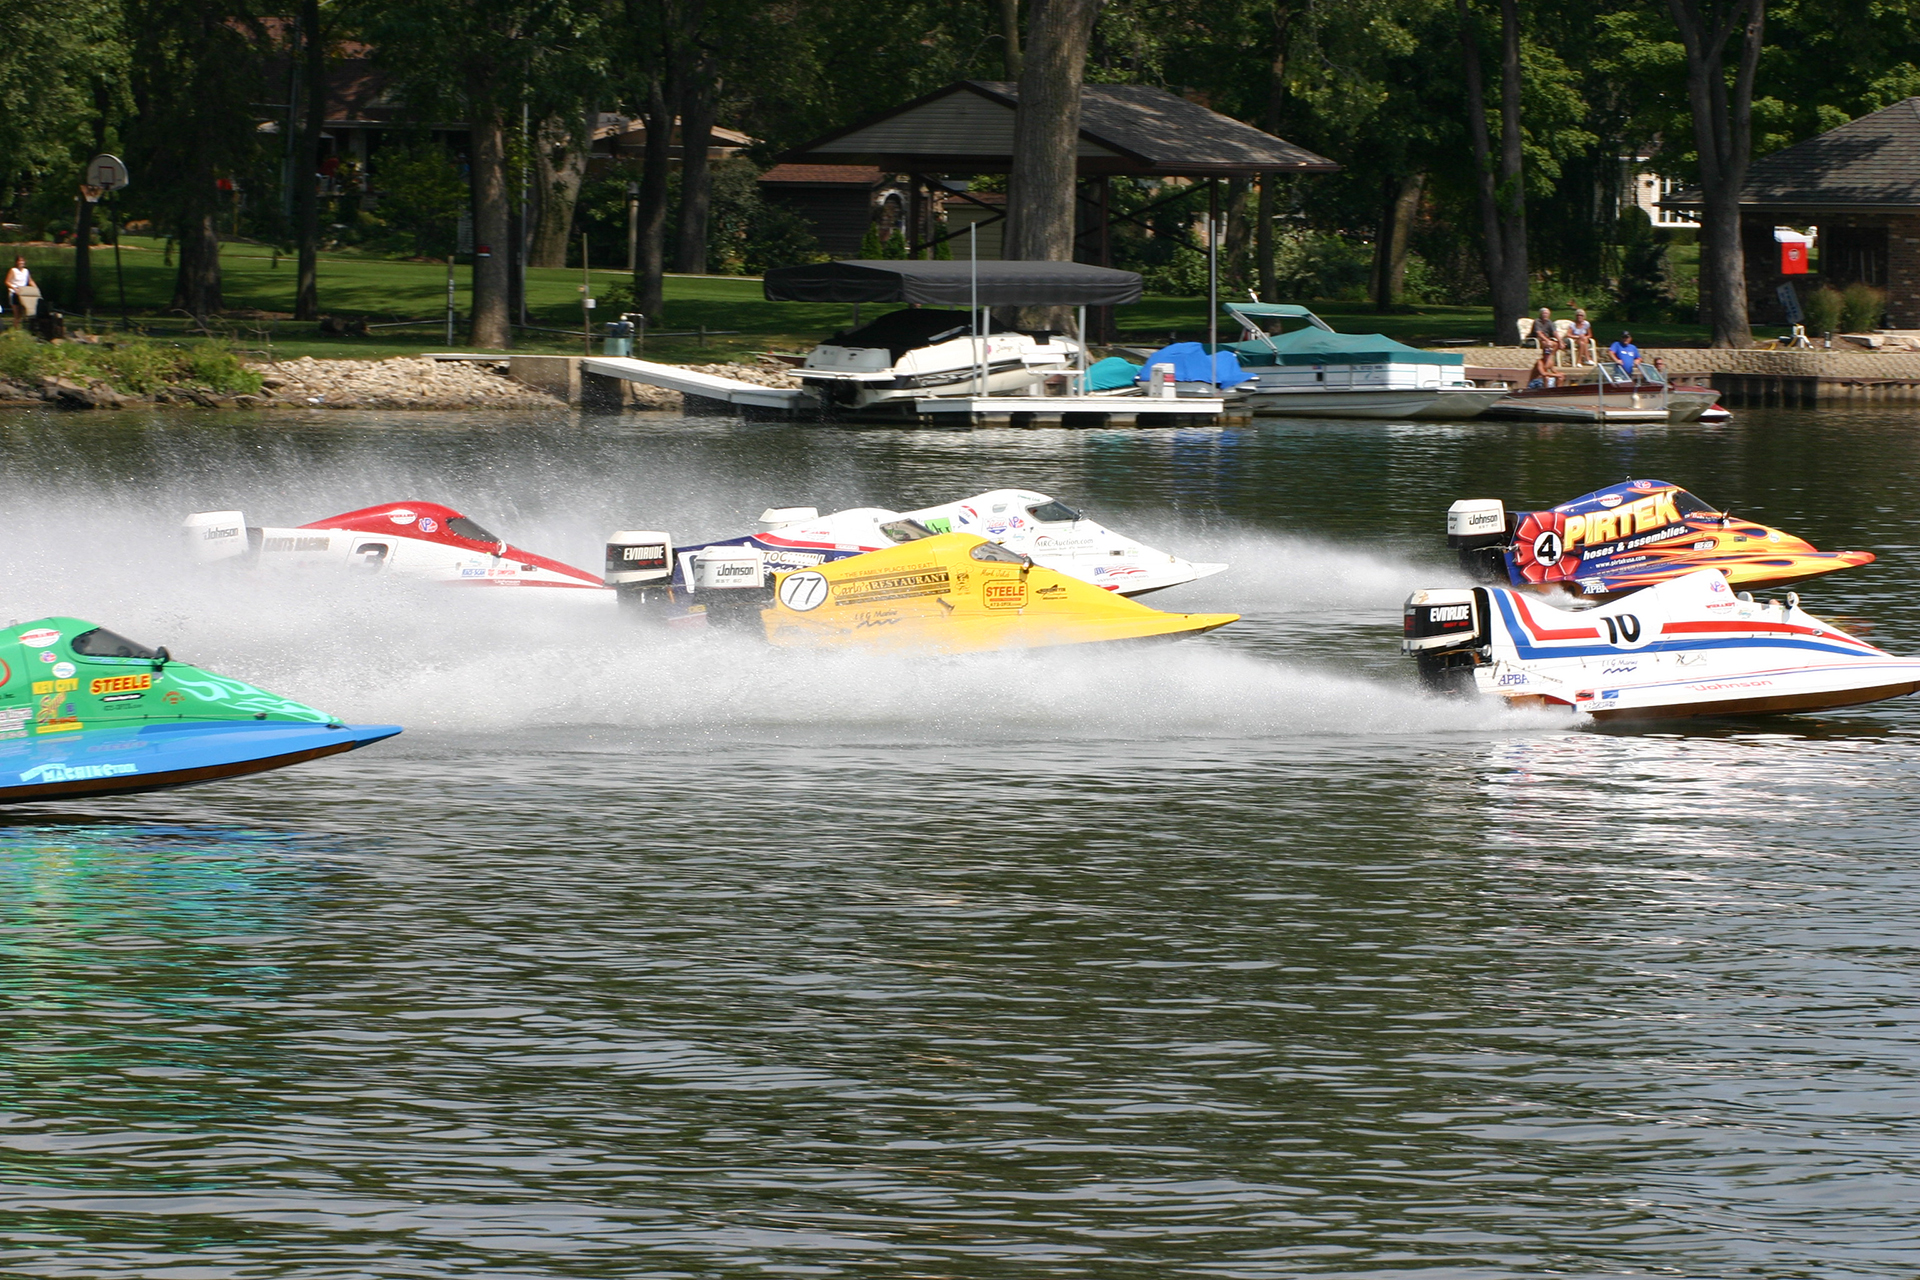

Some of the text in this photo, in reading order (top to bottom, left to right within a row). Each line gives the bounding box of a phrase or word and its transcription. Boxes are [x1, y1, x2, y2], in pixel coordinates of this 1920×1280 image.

[1468, 514, 1498, 526] Johnson
[1564, 490, 1682, 552] PIRTEK
[204, 528, 239, 540] Johnson
[1537, 534, 1557, 561] 4
[1583, 526, 1688, 560] hoses & assemblies.
[356, 543, 389, 574] 3
[623, 545, 664, 561] EVINRUDE
[717, 564, 754, 576] Johnson
[859, 568, 883, 576] FAMILY
[884, 565, 906, 573] PLACE
[788, 576, 822, 605] 77
[831, 573, 948, 597] Carlo's RESTAURANT
[986, 586, 1025, 597] STEELE
[1583, 584, 1609, 594] APBA
[1430, 605, 1470, 622] EVINRUDE
[1600, 613, 1641, 644] 10
[91, 675, 151, 694] STEELE
[1498, 674, 1529, 686] APBA
[1693, 680, 1773, 692] Johnson
